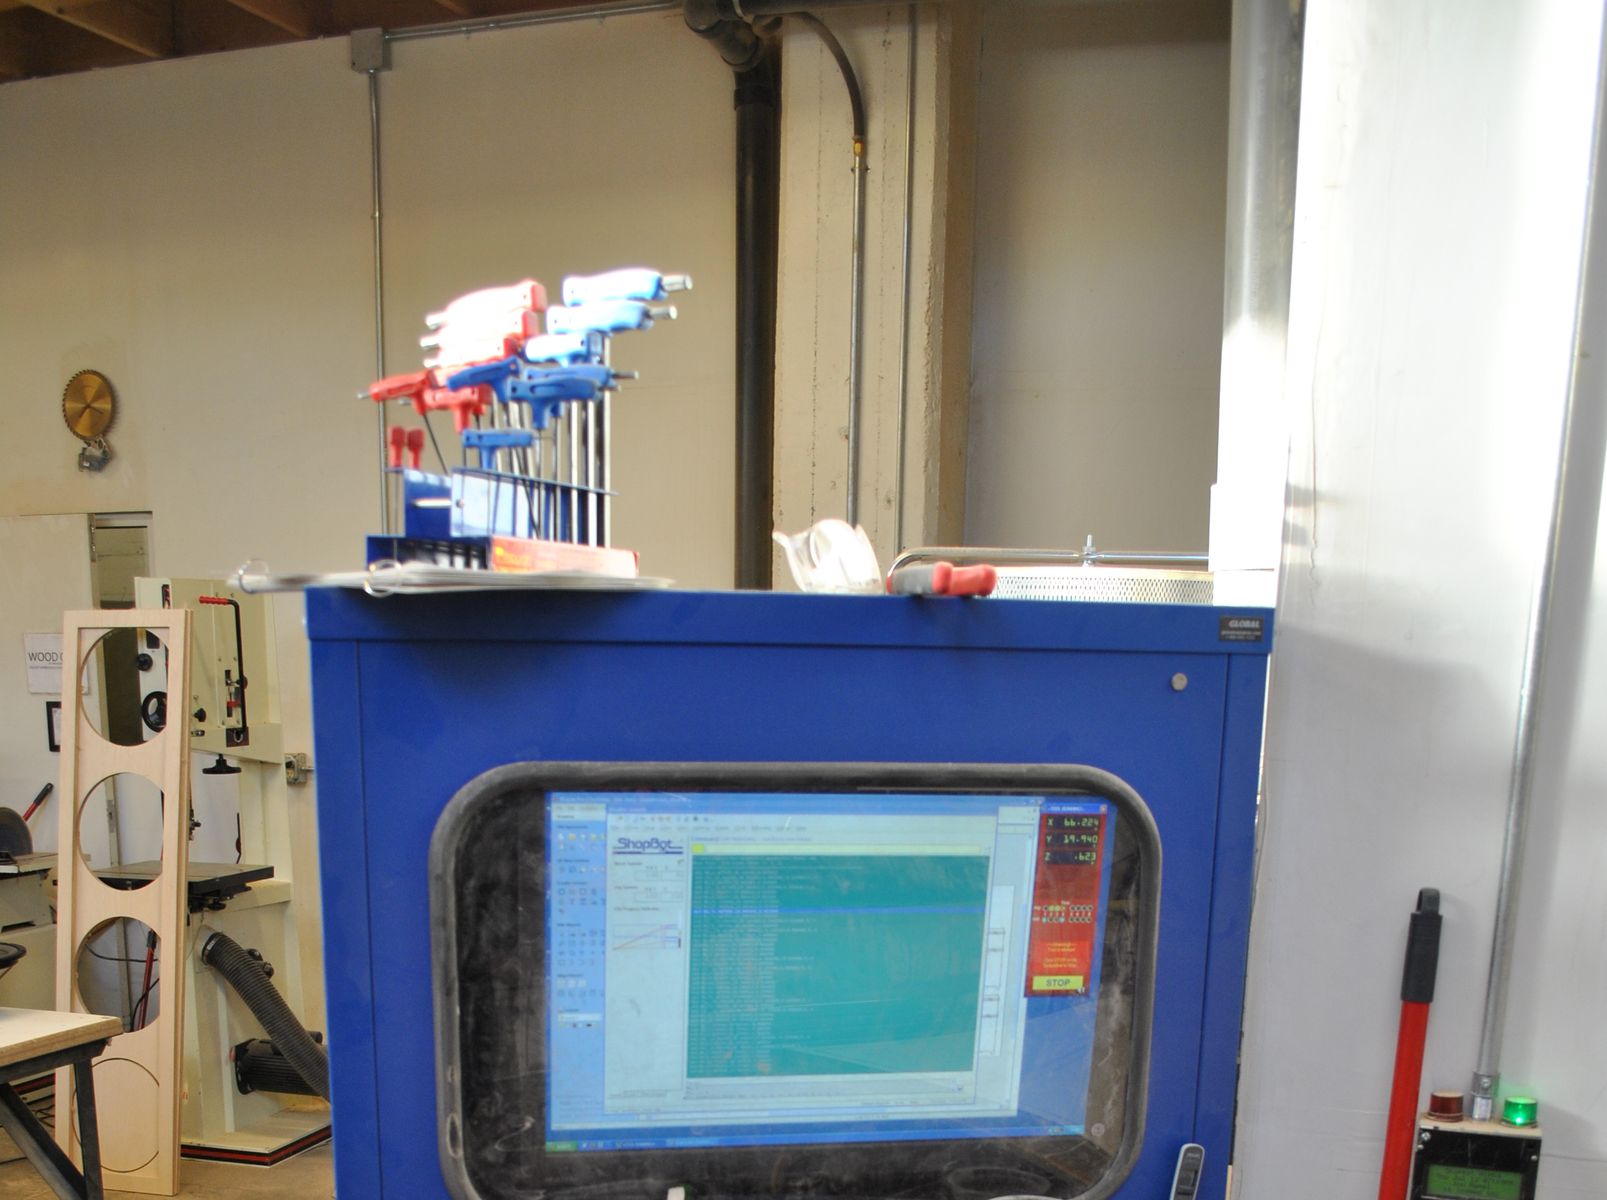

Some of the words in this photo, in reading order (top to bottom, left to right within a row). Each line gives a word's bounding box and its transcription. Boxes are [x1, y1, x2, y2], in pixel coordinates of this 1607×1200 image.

[1228, 620, 1260, 628] GLOBAL
[28, 652, 58, 661] WOOD
[617, 837, 673, 851] ShopBot
[1046, 978, 1071, 988] STOP
